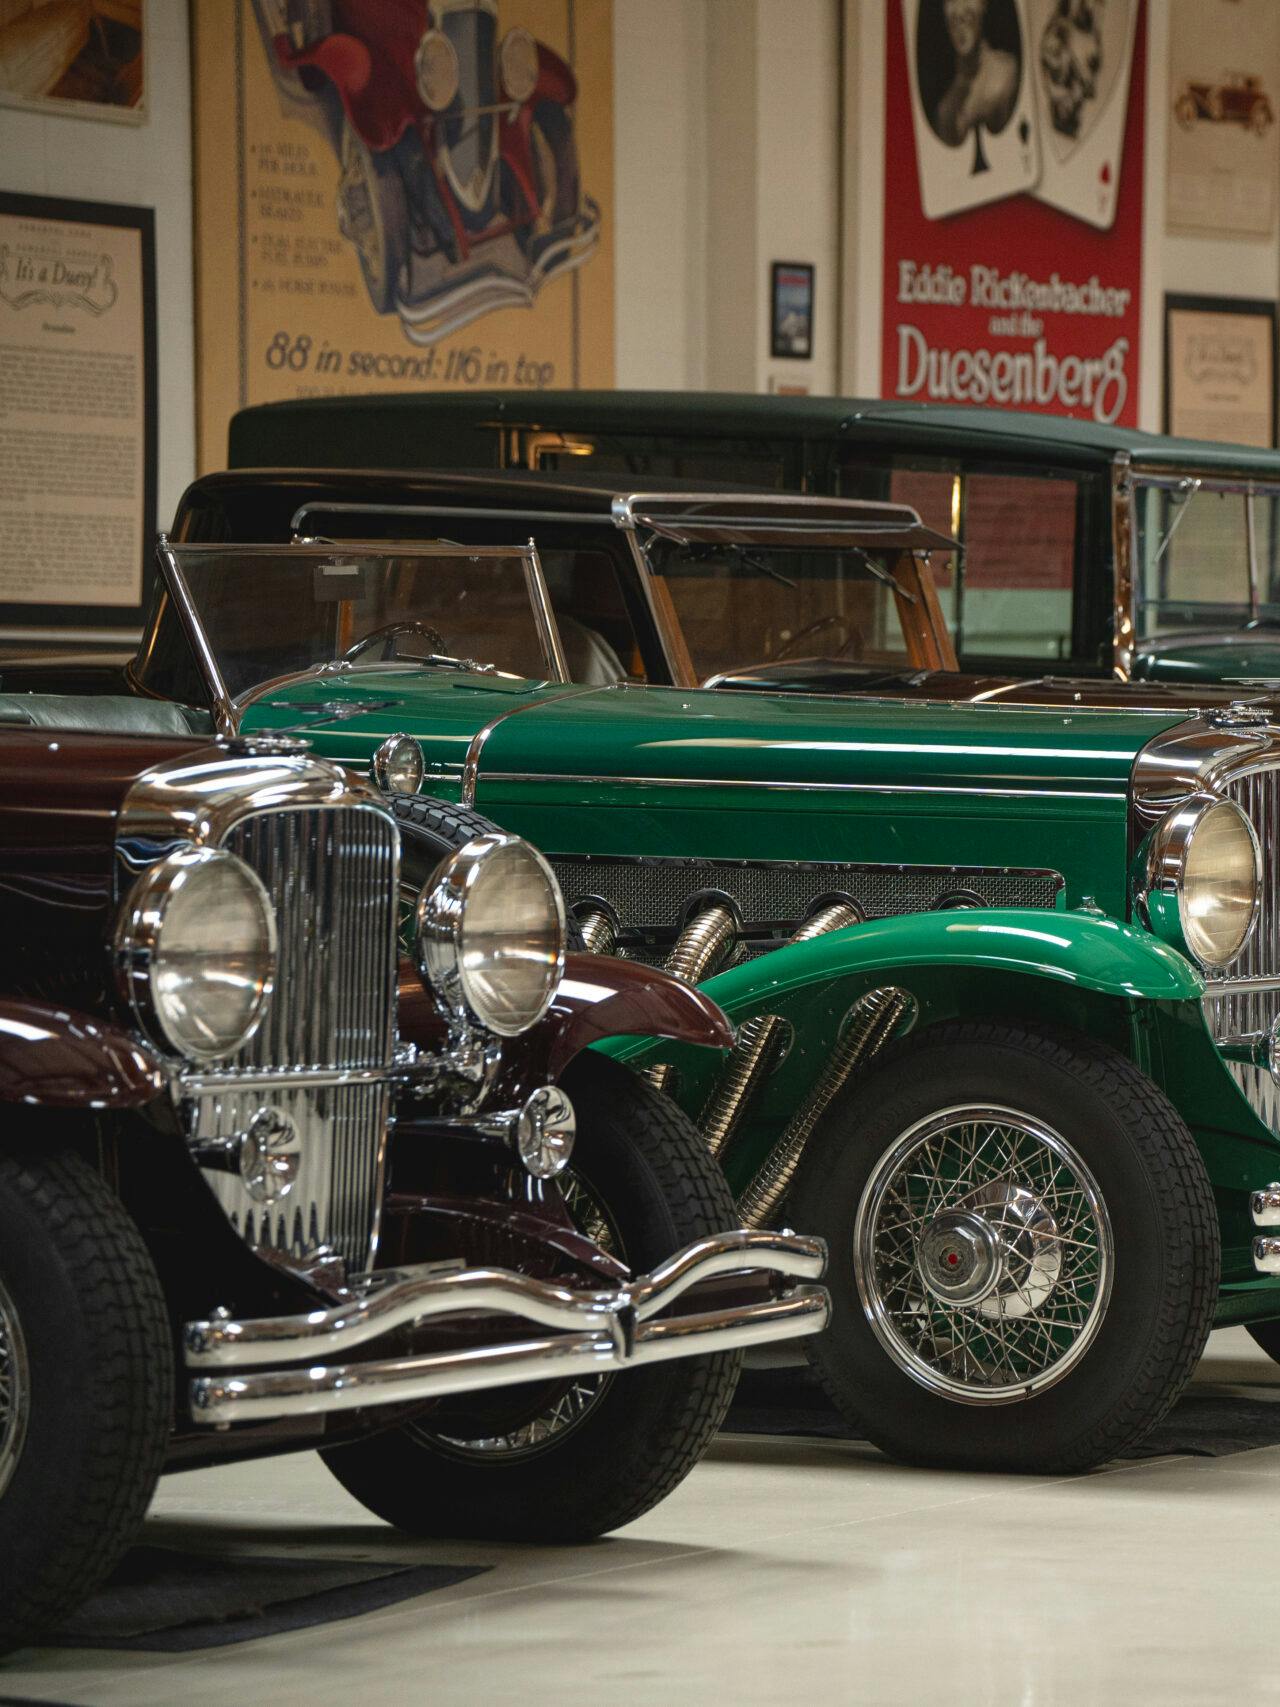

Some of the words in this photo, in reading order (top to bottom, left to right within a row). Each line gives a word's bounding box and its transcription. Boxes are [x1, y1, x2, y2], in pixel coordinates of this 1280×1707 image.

[897, 259, 966, 305] Eddie
[988, 312, 1017, 336] and
[1019, 311, 1044, 337] the
[265, 331, 312, 371] 88
[314, 340, 342, 373] in
[444, 346, 481, 384] 116
[485, 351, 508, 384] in
[514, 353, 555, 391] top
[896, 323, 1130, 424] Duesenberg
